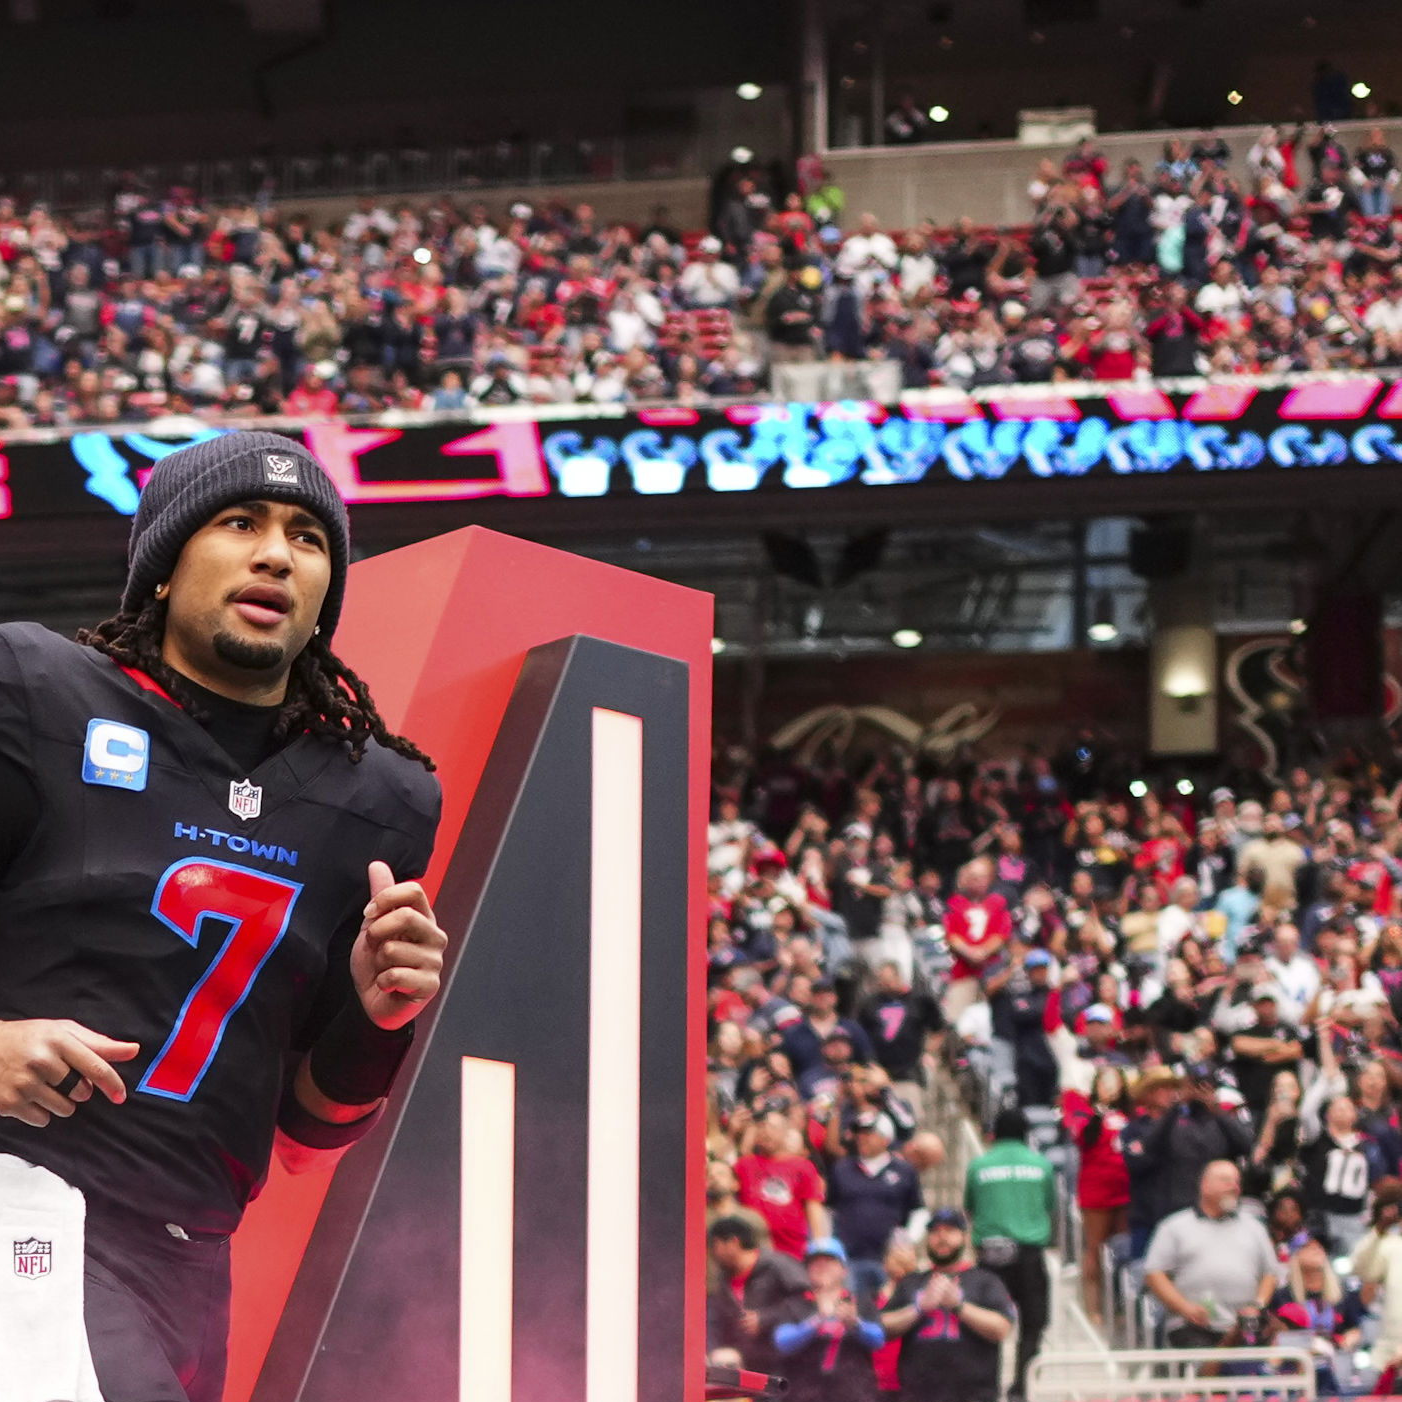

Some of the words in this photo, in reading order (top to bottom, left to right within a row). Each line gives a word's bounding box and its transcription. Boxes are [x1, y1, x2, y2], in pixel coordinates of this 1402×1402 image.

[90, 724, 145, 772] C
[235, 796, 256, 812] NFL
[174, 822, 298, 866] H-TOWN
[135, 856, 305, 1102] 7
[1324, 1148, 1368, 1199] 10
[17, 1255, 47, 1275] NFL
